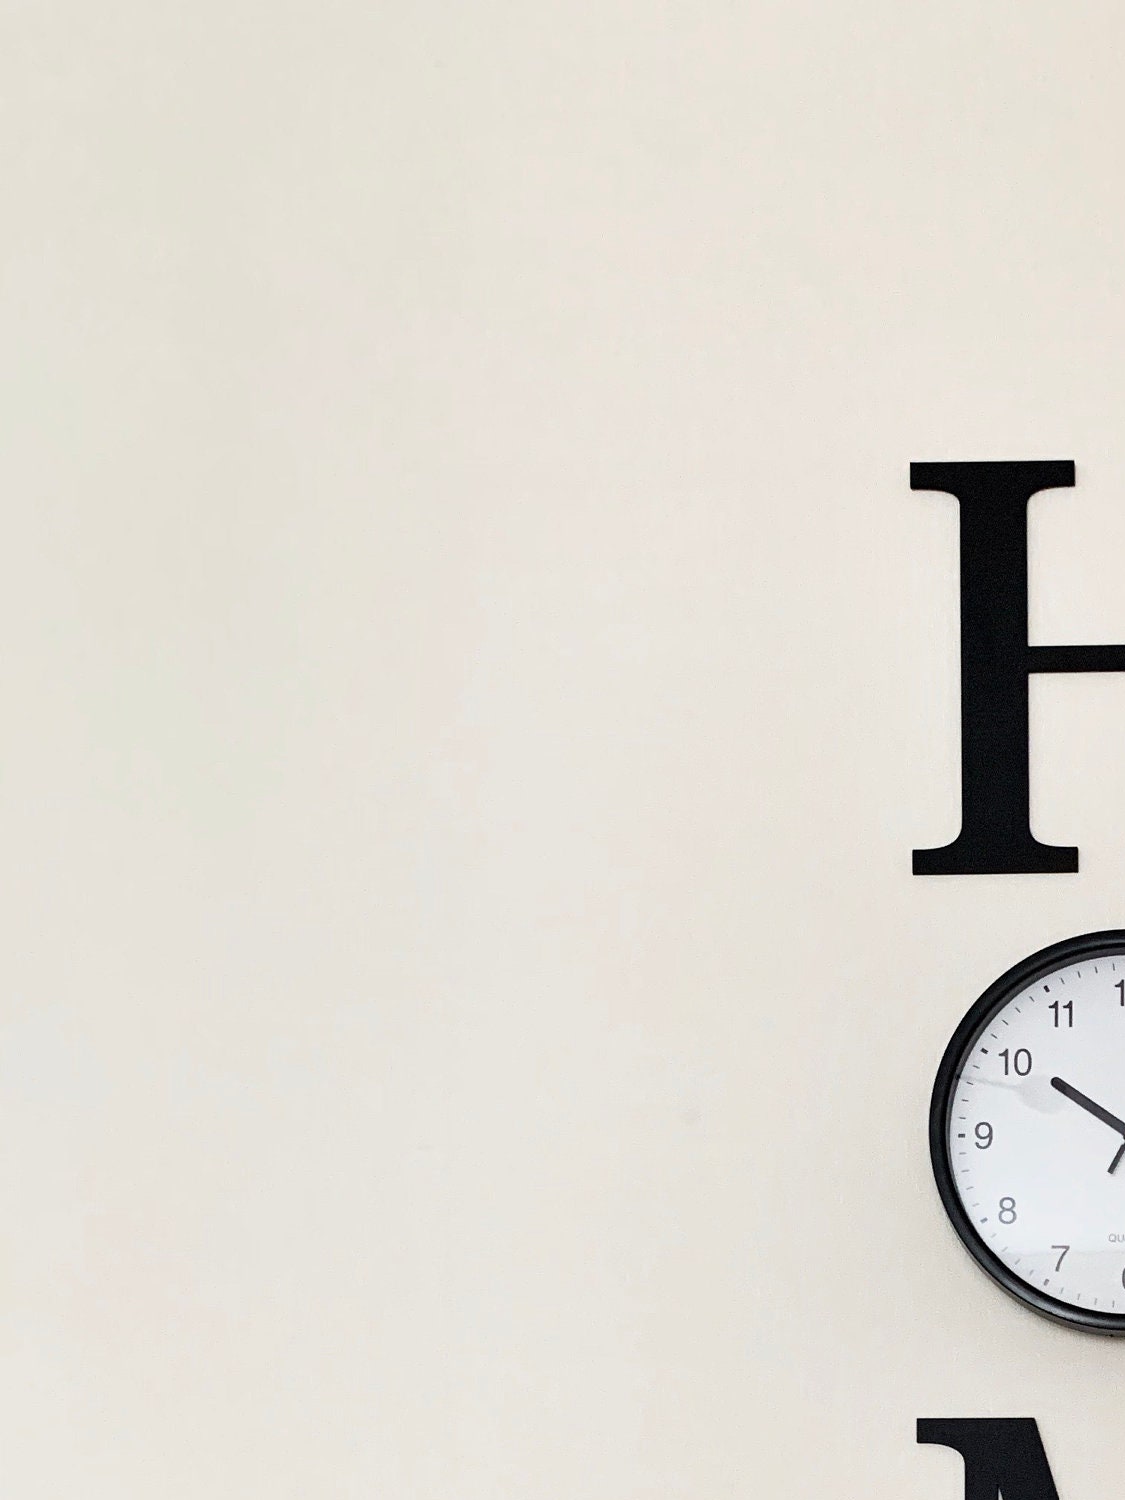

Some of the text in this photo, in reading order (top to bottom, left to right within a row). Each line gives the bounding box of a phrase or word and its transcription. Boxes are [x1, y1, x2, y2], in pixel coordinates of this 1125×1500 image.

[1048, 1000, 1074, 1028] 11
[998, 1048, 1033, 1076] 10
[974, 1121, 994, 1150] 9
[997, 1196, 1018, 1225] 8
[1051, 1245, 1070, 1272] 7
